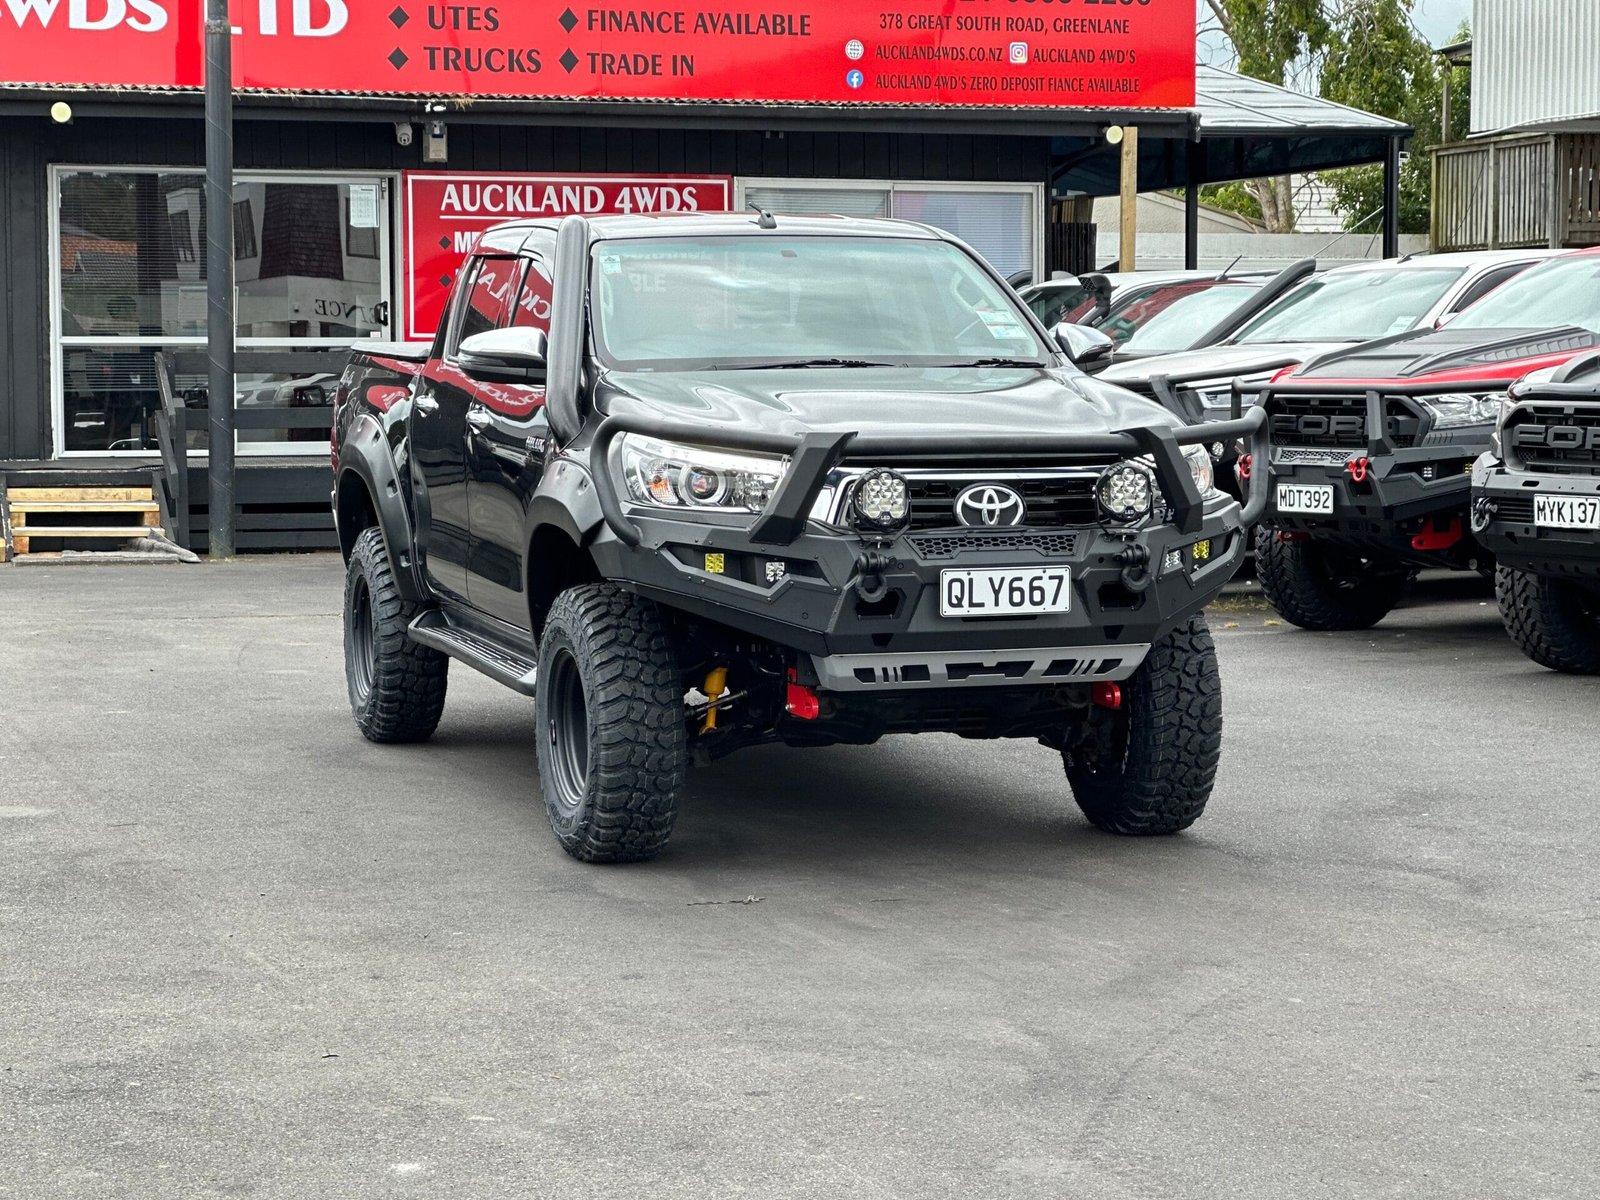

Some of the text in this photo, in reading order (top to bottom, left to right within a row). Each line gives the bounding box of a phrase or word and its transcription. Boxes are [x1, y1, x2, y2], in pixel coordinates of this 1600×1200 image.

[0, 0, 168, 32] WDS
[427, 5, 499, 31] UTES
[587, 9, 811, 36] FINANCE AVAILABLE
[879, 14, 1130, 35] 378 GREAT SOUTH ROAD, GREENLANE
[423, 46, 542, 74] TRUCKS
[587, 52, 695, 77] TRADE IN
[875, 45, 1003, 62] AUCKLAND4WDS.CO.NZ
[1033, 47, 1136, 64] AUCKLAND 4WD'S
[875, 73, 1140, 93] AUCKLAND 4WD'S ZERO DEPOSIT FIANCE AVAILABLE
[440, 184, 698, 214] AUCKLAND 4WDS
[1279, 489, 1330, 508] MDT392
[1536, 500, 1597, 524] MYK137
[947, 574, 1065, 608] QLY667
